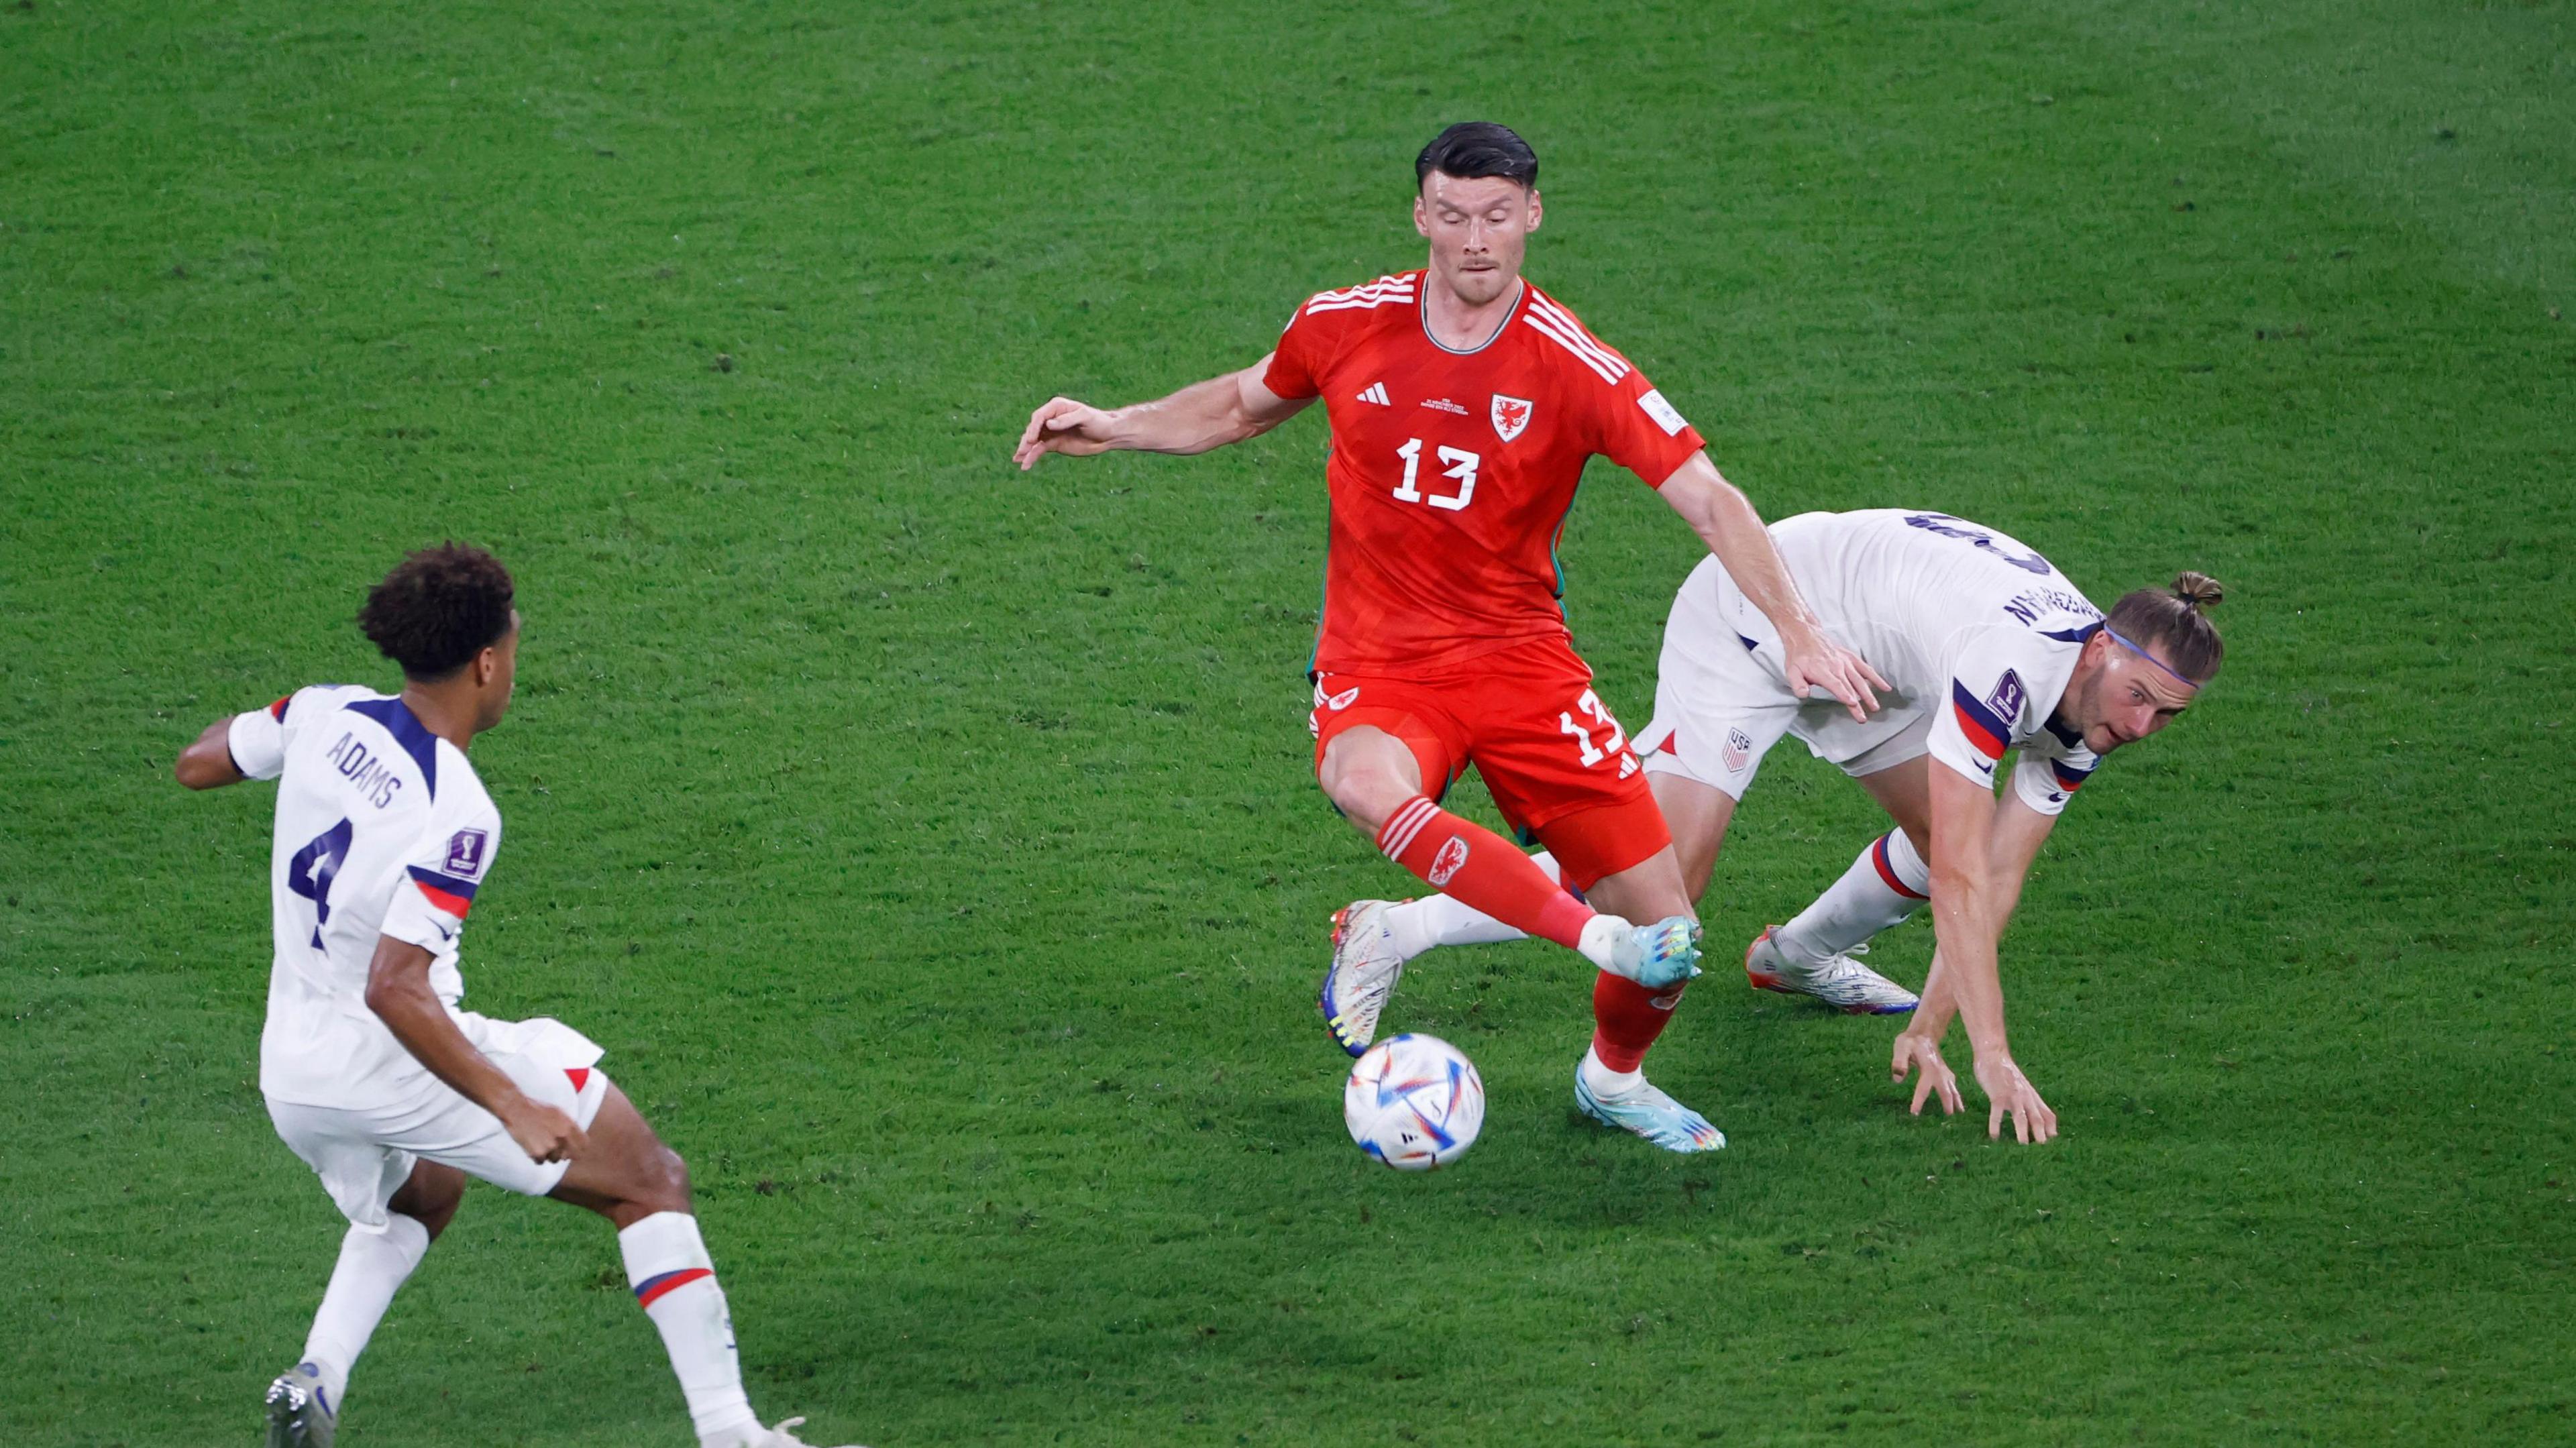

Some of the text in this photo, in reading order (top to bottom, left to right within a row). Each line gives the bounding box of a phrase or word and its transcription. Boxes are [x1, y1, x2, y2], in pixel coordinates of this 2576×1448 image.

[1393, 437, 1480, 511] 13
[1559, 688, 1624, 767] 13
[1731, 730, 1750, 750] USA
[327, 732, 402, 809] ADAMS
[288, 817, 353, 952] 4
